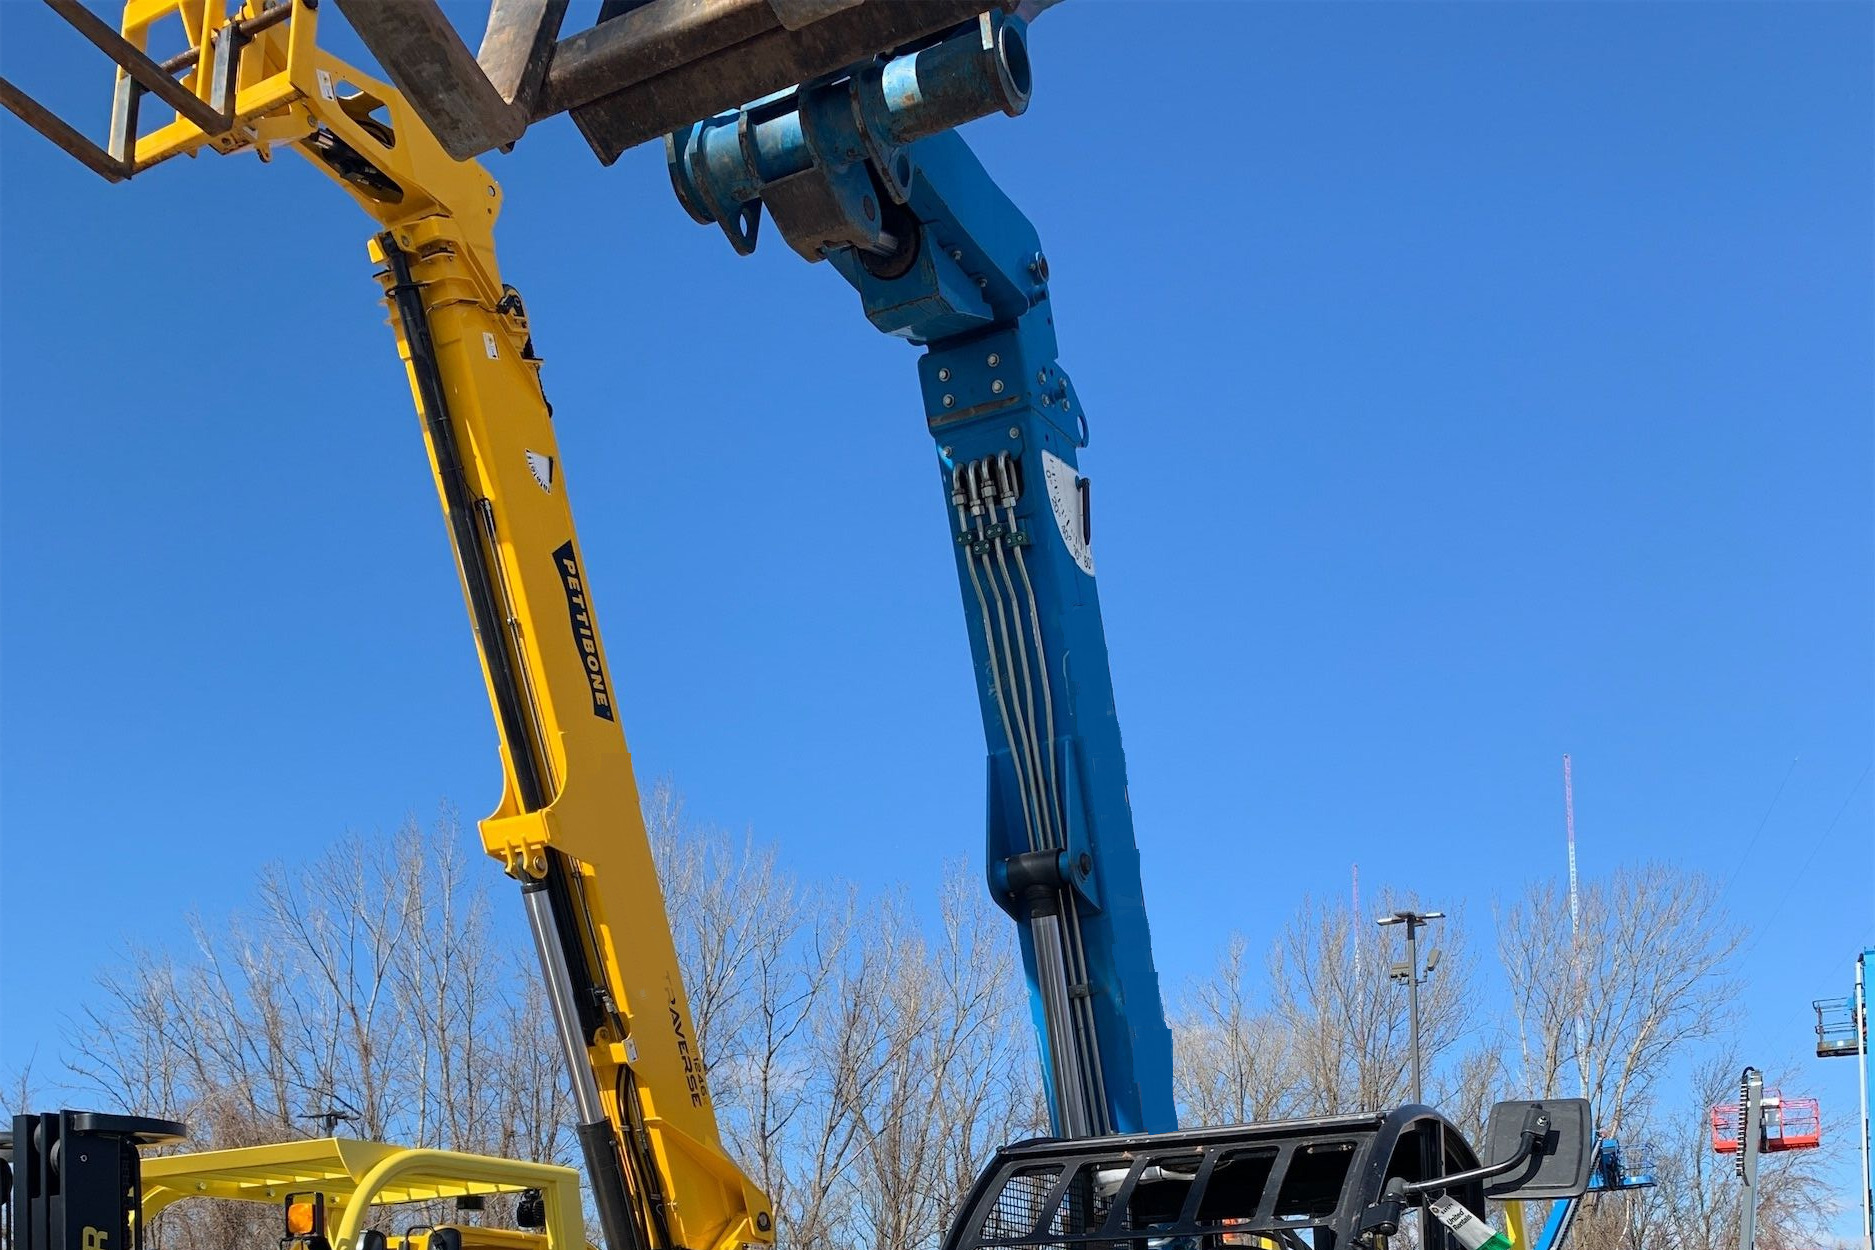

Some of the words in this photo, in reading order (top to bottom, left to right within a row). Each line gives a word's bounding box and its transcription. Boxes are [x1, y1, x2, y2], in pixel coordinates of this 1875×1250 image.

[562, 557, 609, 707] PETTIBONE
[664, 970, 703, 1110] TRAVERSE
[1446, 1208, 1465, 1225] United
[1452, 1214, 1473, 1231] Rentals
